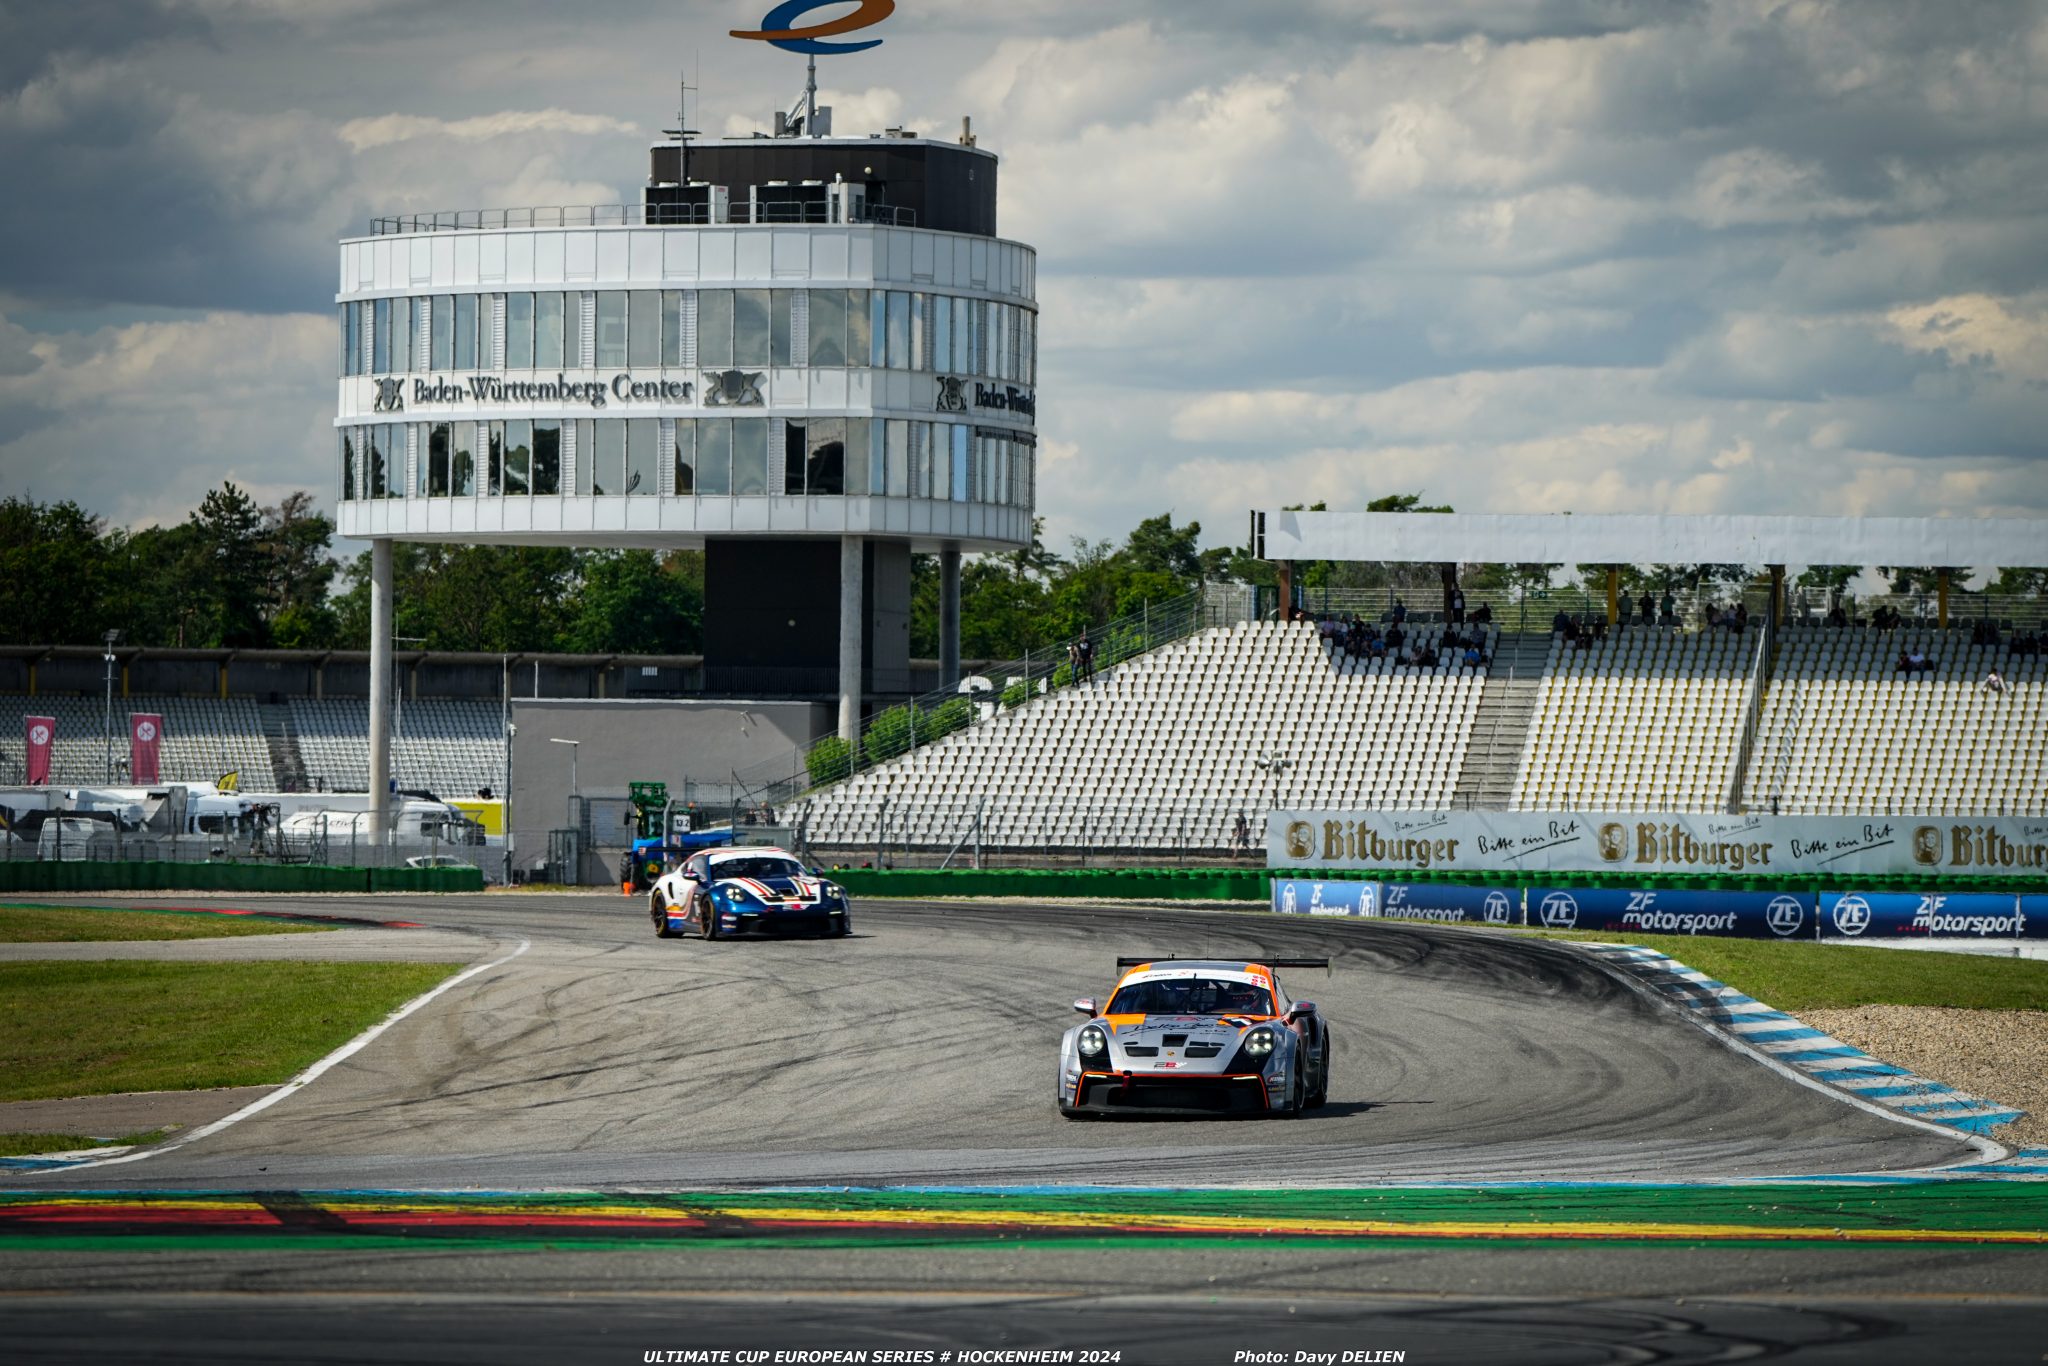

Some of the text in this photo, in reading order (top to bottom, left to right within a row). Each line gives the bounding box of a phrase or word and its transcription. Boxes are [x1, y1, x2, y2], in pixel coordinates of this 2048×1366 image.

[414, 373, 693, 407] Baden-Württemberg Center
[1321, 819, 1459, 868] Bitburger
[1478, 820, 1579, 854] Bitte ein Bit
[1634, 822, 1773, 871] Bitburger
[1791, 824, 1894, 859] Bitte ein Bit
[1949, 825, 2048, 871] Bitbur
[1387, 885, 1408, 905] ZF
[1626, 892, 1656, 911] ZF
[1917, 896, 1947, 914] ZF
[1544, 900, 1574, 923] ZF
[1622, 910, 1737, 935] motorsport
[1770, 903, 1799, 926] ZF
